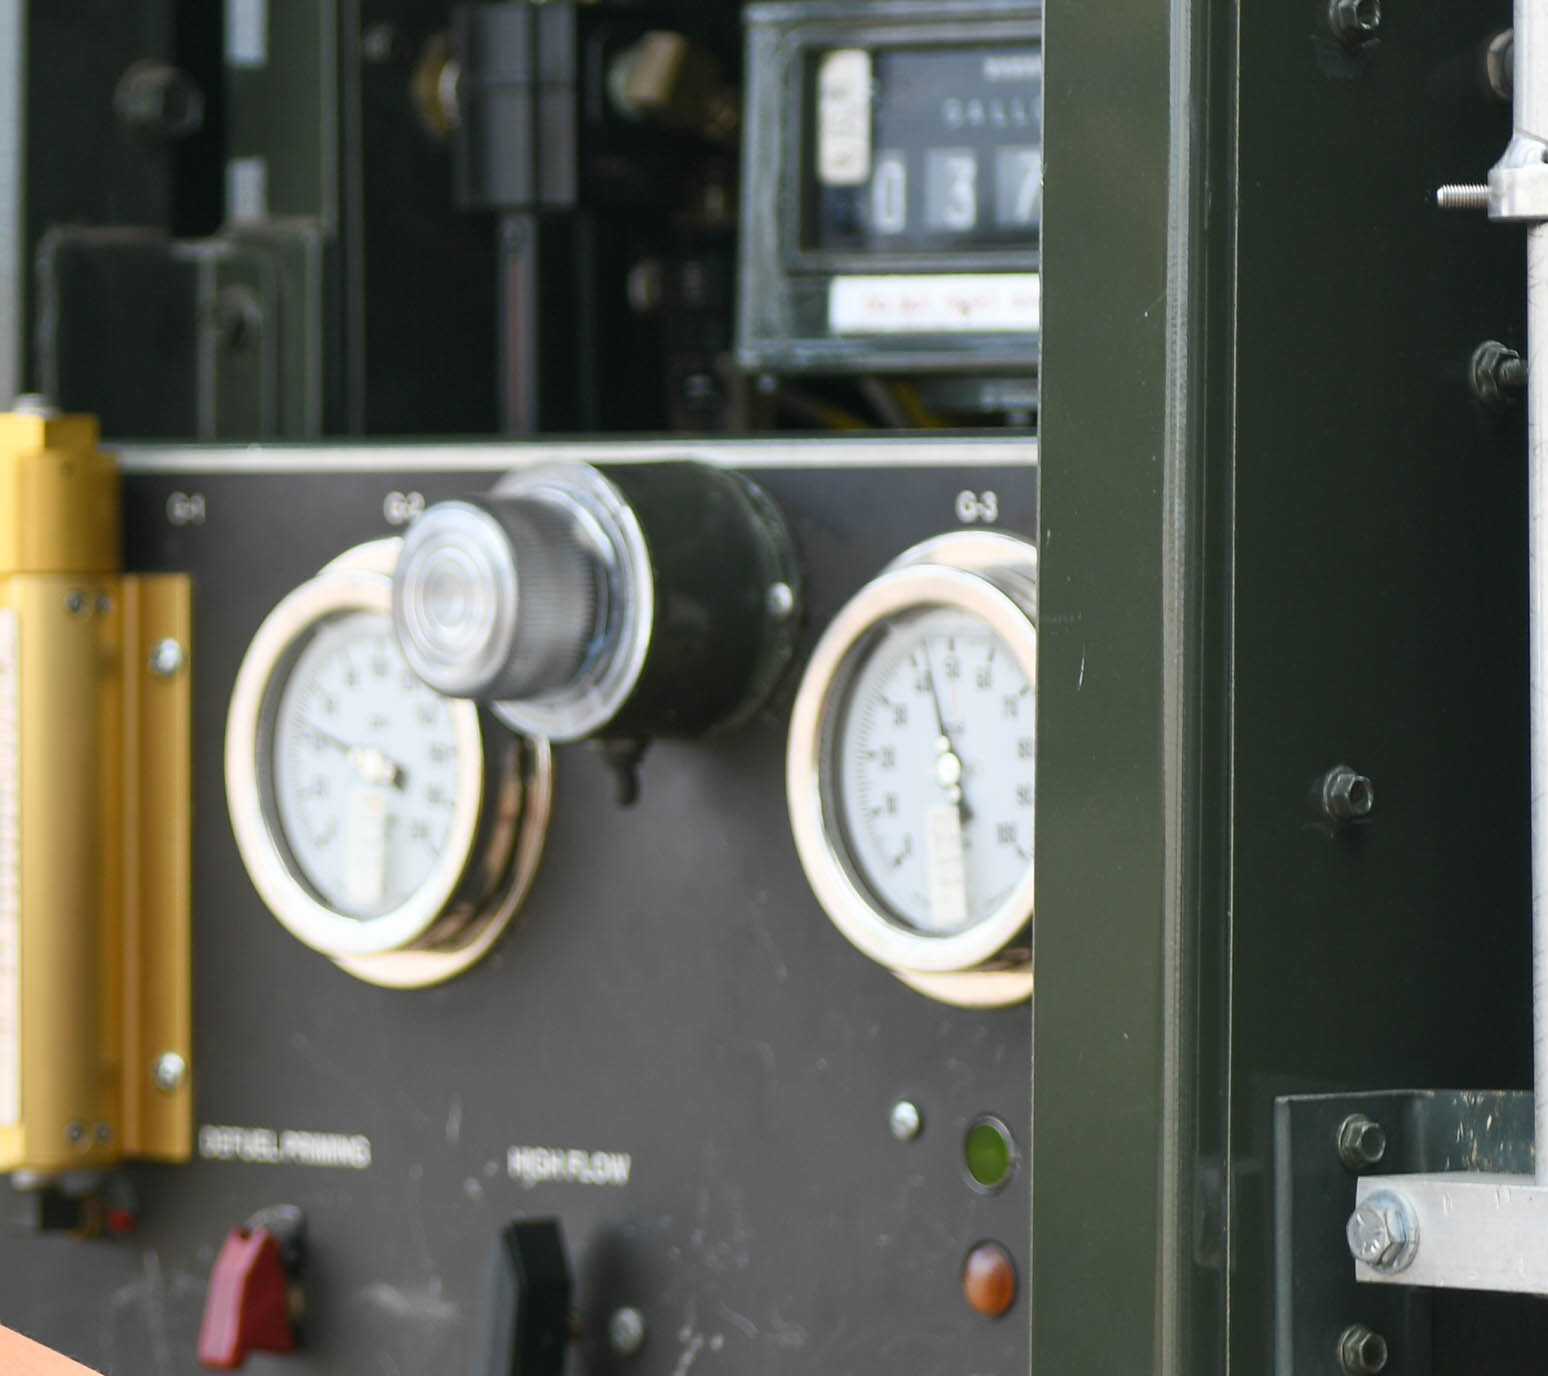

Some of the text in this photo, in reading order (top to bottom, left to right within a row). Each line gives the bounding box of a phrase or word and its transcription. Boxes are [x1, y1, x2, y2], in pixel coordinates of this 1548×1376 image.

[383, 491, 425, 525] G-2
[957, 490, 999, 521] G-3
[506, 1145, 632, 1186] HIGH FLOW
